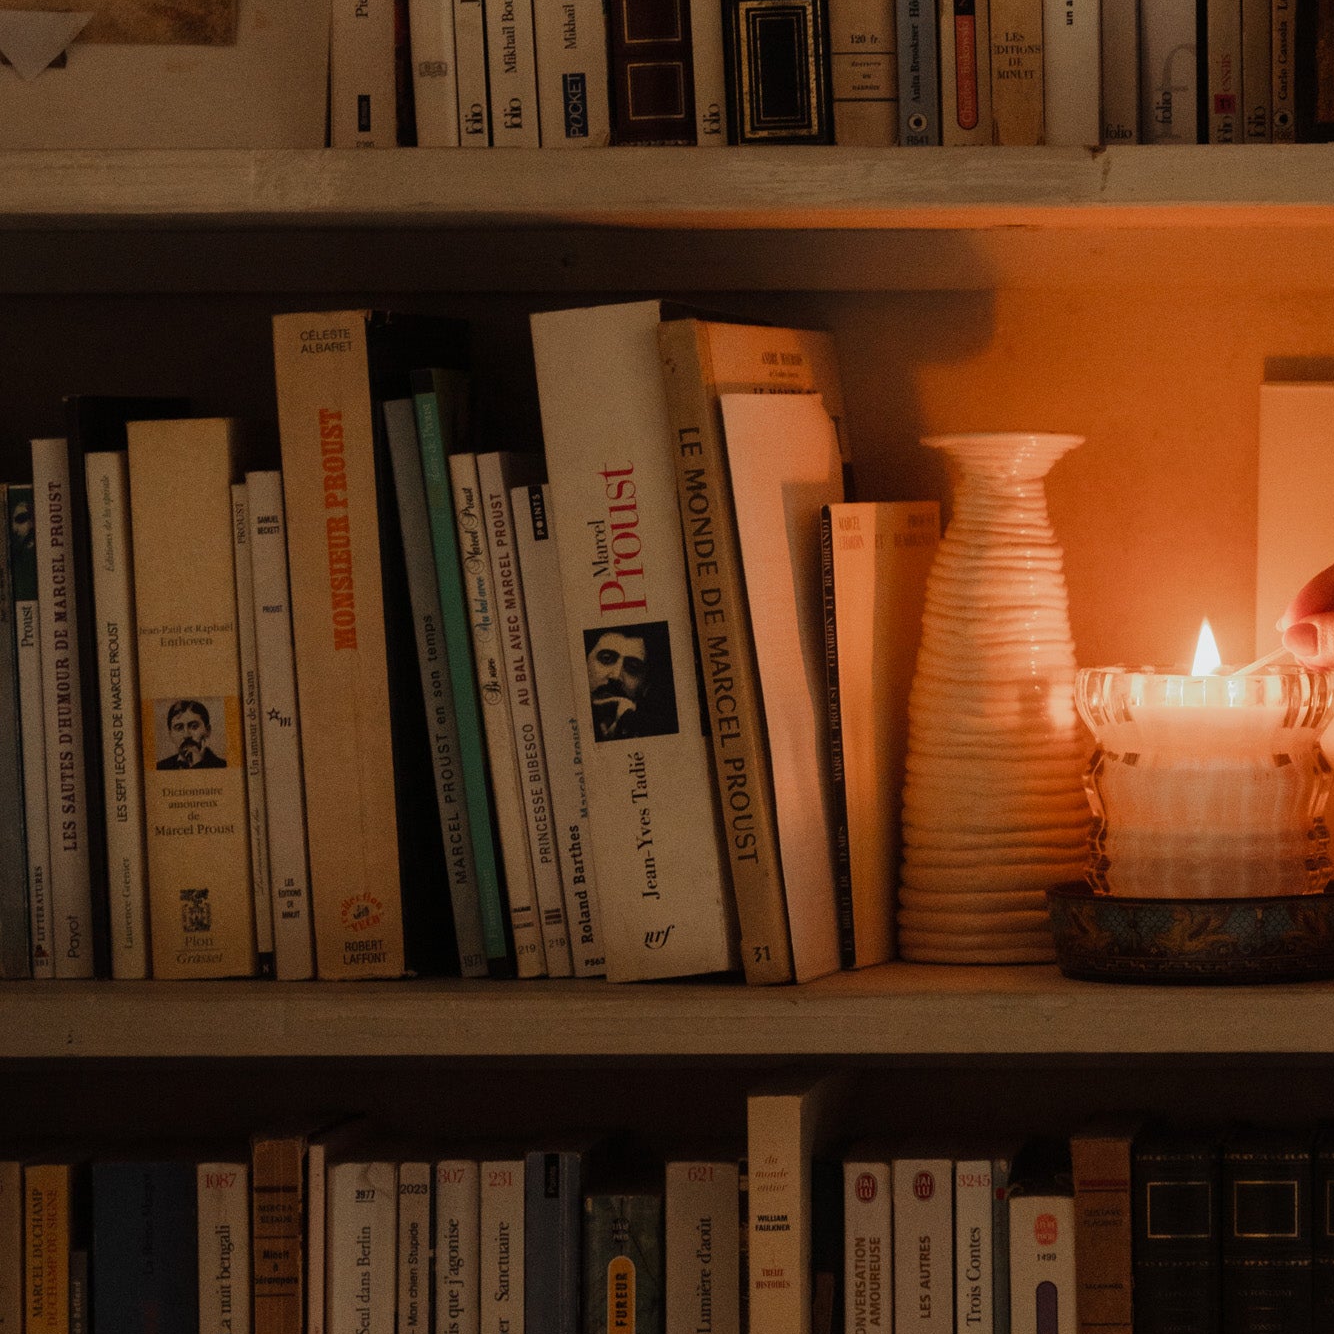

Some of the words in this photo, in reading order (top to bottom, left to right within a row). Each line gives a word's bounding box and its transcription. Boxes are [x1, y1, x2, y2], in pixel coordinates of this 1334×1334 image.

[501, 26, 517, 73] Mikhaïl
[561, 4, 576, 49] Mikhaïl
[465, 103, 483, 134] folio
[504, 98, 523, 129] folio
[566, 74, 585, 137] POCKET
[1155, 92, 1173, 124] folio
[300, 341, 352, 354] ALBARET
[319, 408, 349, 509] PROUST
[678, 426, 702, 457] LE
[489, 493, 508, 547] PROUST
[600, 462, 647, 617] Proust
[684, 470, 718, 576] MONDE
[592, 520, 608, 579] Marcel
[326, 516, 358, 651] MONSIEUR
[496, 552, 519, 610] MARCEL
[20, 606, 35, 647] Proust
[701, 589, 725, 626] DE
[420, 614, 440, 662] temps
[505, 615, 523, 651] AVEC
[429, 671, 444, 697] son
[512, 654, 528, 683] BAL
[707, 636, 741, 748] MARCEL
[436, 706, 447, 725] en
[517, 687, 531, 707] AU
[436, 732, 455, 804] PROUST
[521, 723, 541, 782] BIBESCO
[629, 751, 647, 798] Tadié
[531, 788, 553, 864] PRINCESSE
[724, 756, 759, 865] PROUST
[447, 814, 468, 885] MARCEL
[567, 825, 588, 886] Barthes
[633, 801, 661, 900] Jean-Yves
[574, 891, 594, 944] Roland
[643, 925, 674, 949] nrf
[343, 953, 387, 965] LAFFONT
[345, 940, 384, 952] ROBERT
[494, 1222, 510, 1302] Sanctuaire
